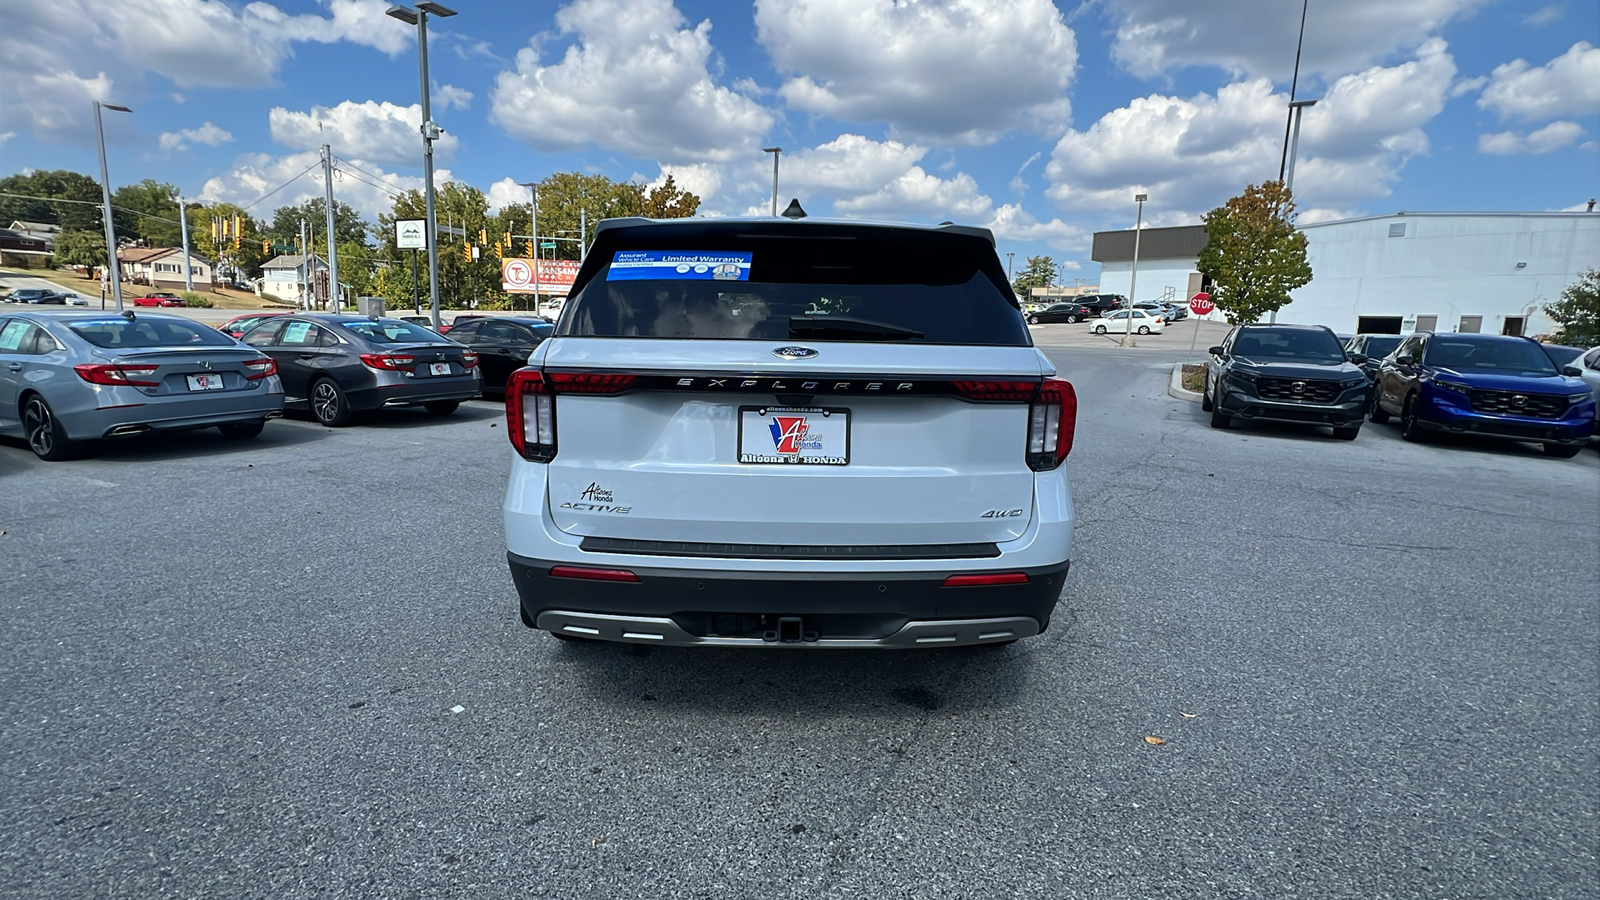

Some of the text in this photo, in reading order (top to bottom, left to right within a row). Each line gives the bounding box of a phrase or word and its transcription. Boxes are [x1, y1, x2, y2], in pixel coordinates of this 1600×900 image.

[1191, 299, 1213, 309] STOP
[782, 347, 809, 357] Ford
[676, 377, 914, 391] EXPLORER
[796, 440, 822, 450] Honda
[740, 454, 785, 463] Altoona
[803, 455, 847, 464] HONDA
[560, 502, 632, 514] ACTIVE
[981, 509, 1023, 518] 4WD
